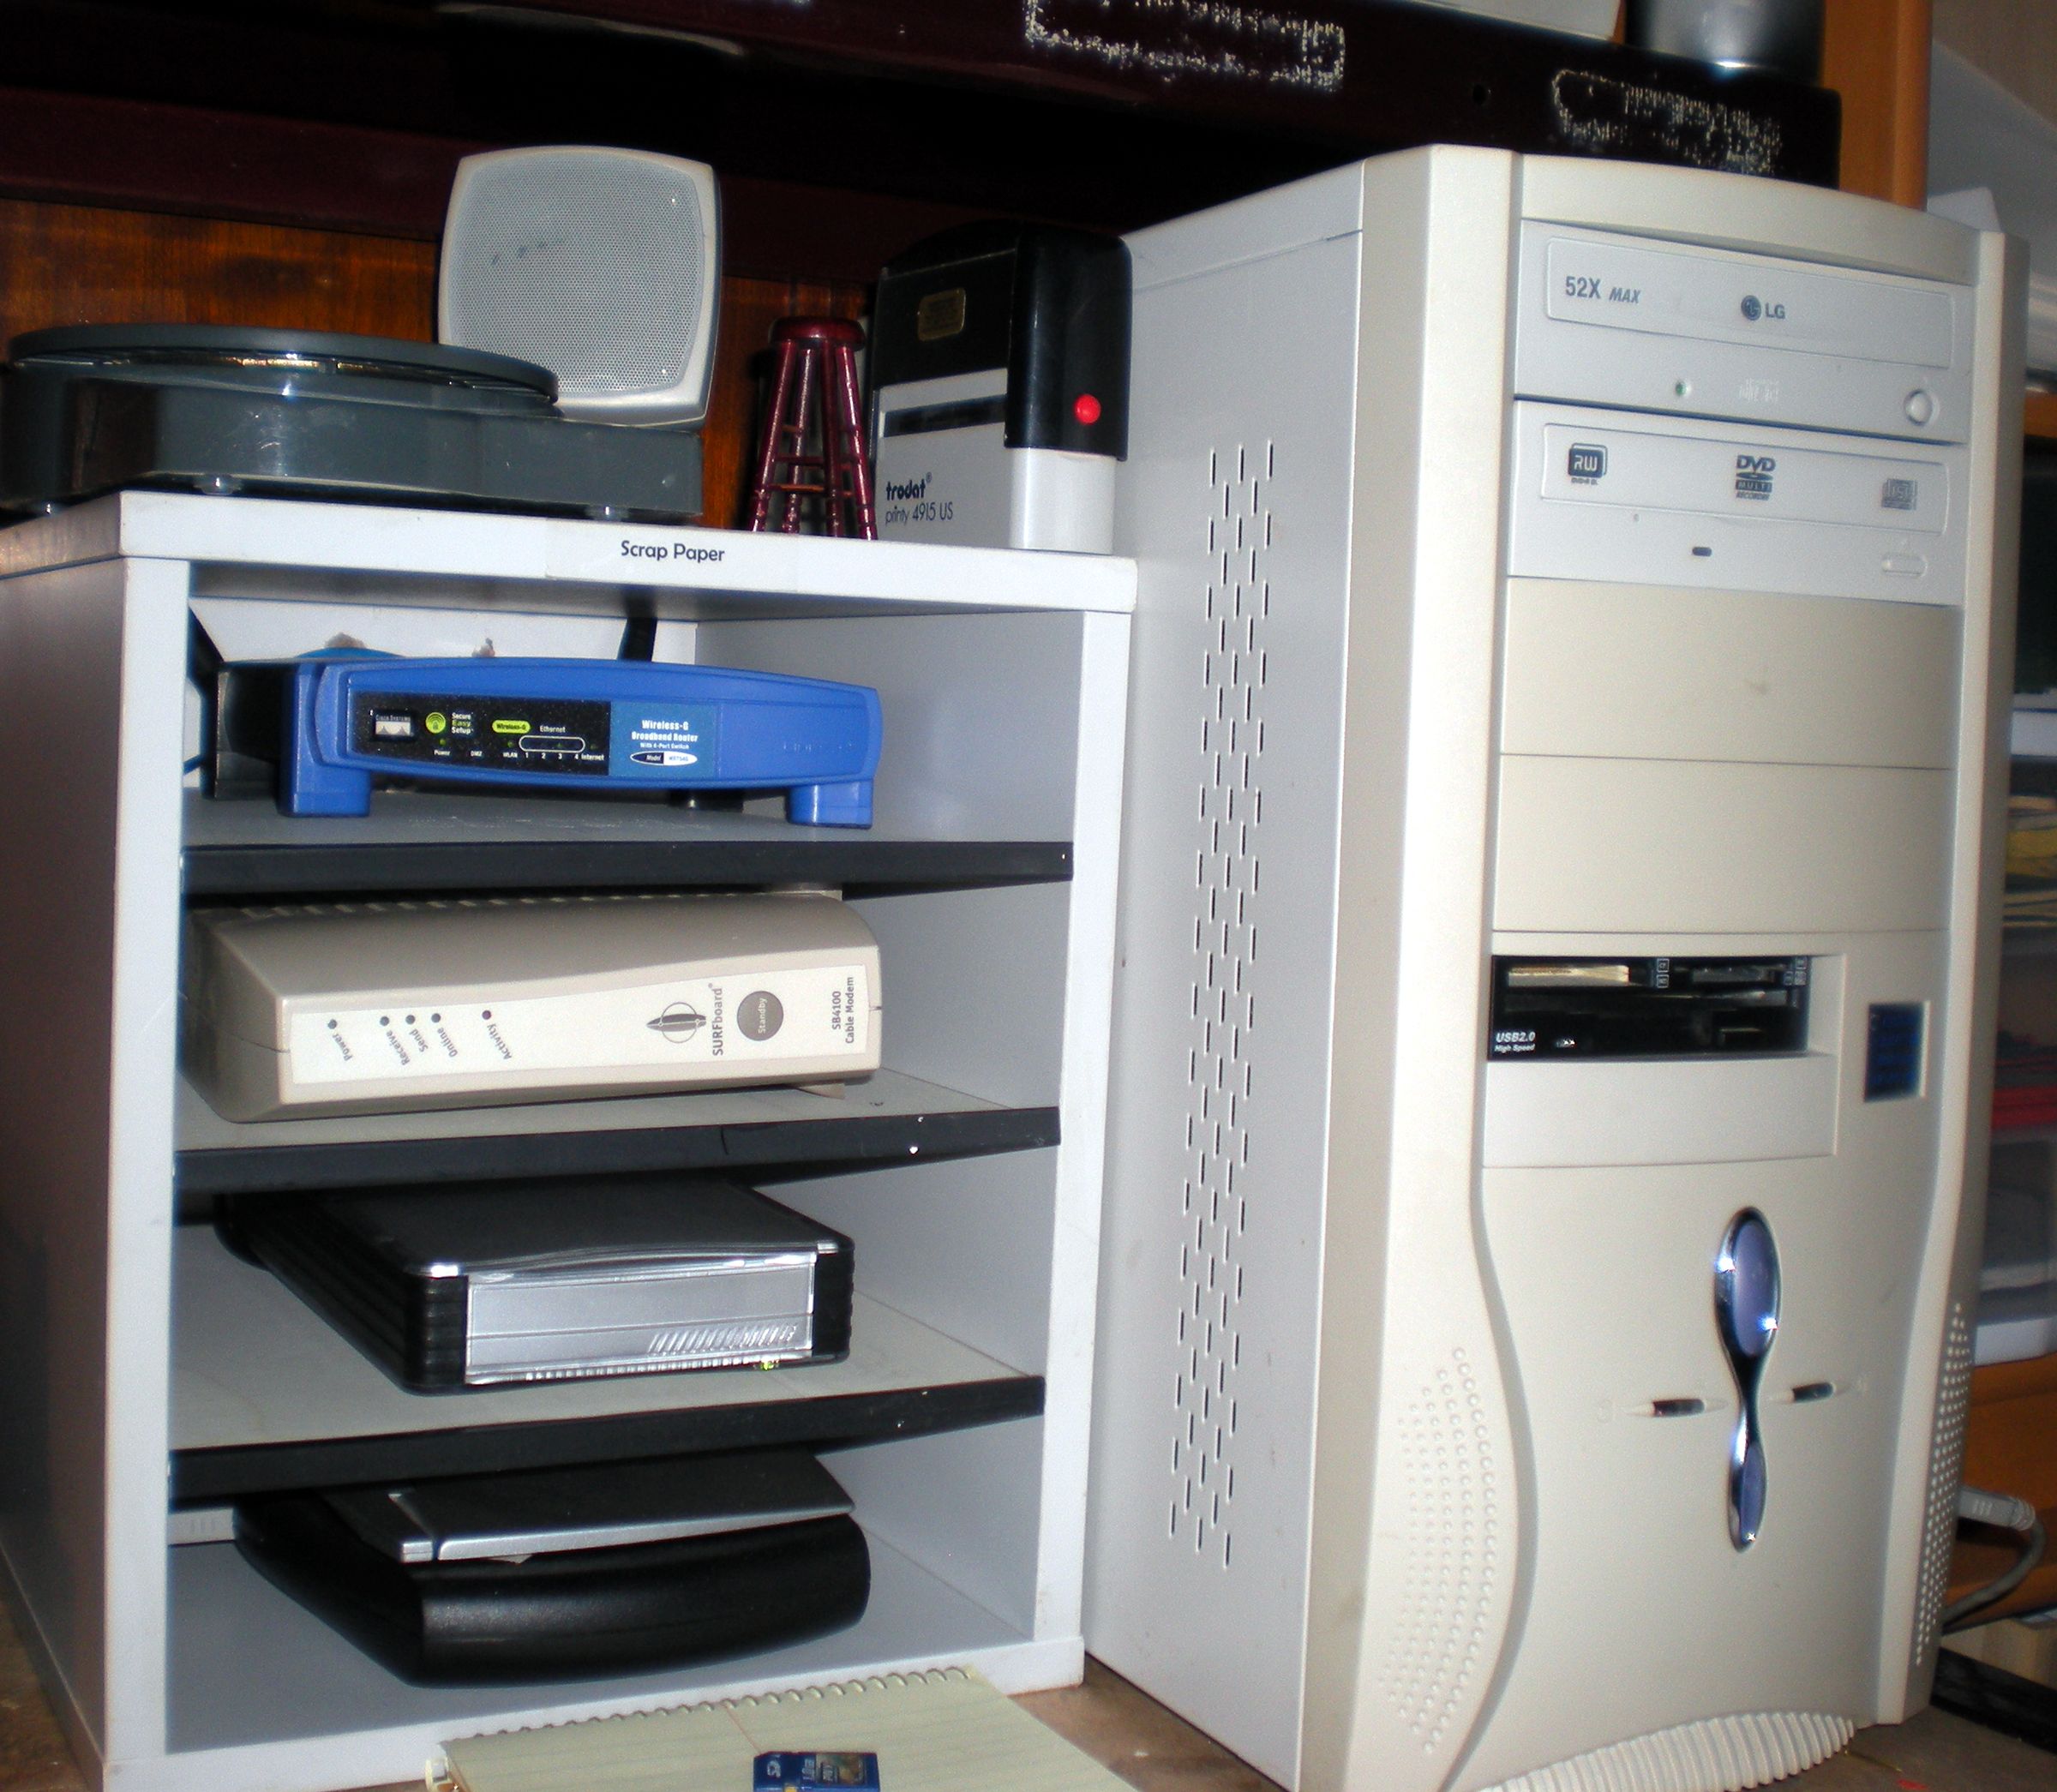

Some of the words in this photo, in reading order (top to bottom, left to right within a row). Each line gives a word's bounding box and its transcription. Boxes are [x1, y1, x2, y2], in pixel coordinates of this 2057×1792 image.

[1565, 276, 1601, 299] 52X
[1609, 287, 1640, 303] MAX
[1766, 303, 1785, 320] LG
[1736, 455, 1776, 472] DVD
[886, 478, 926, 500] trodat
[885, 506, 910, 526] printy
[912, 501, 936, 521] 4915
[939, 501, 953, 521] US
[621, 540, 668, 561] Scrap
[674, 543, 725, 563] Paper
[631, 731, 672, 741] Broadband
[673, 733, 699, 742] Router
[641, 720, 689, 731] Wireless-G
[845, 977, 855, 1013] Modem
[712, 988, 723, 1056] SURFboard
[758, 998, 768, 1034] Standby
[832, 991, 842, 1030] SB4100
[409, 1028, 429, 1053] Send
[436, 1027, 459, 1058] Online
[487, 1022, 513, 1060] Activity
[845, 1016, 855, 1044] Cable
[1496, 1031, 1536, 1043] USB2.0
[332, 1032, 354, 1062] Power
[385, 1030, 411, 1066] Receive
[1494, 1045, 1511, 1053] High
[1513, 1043, 1536, 1053] Speed
